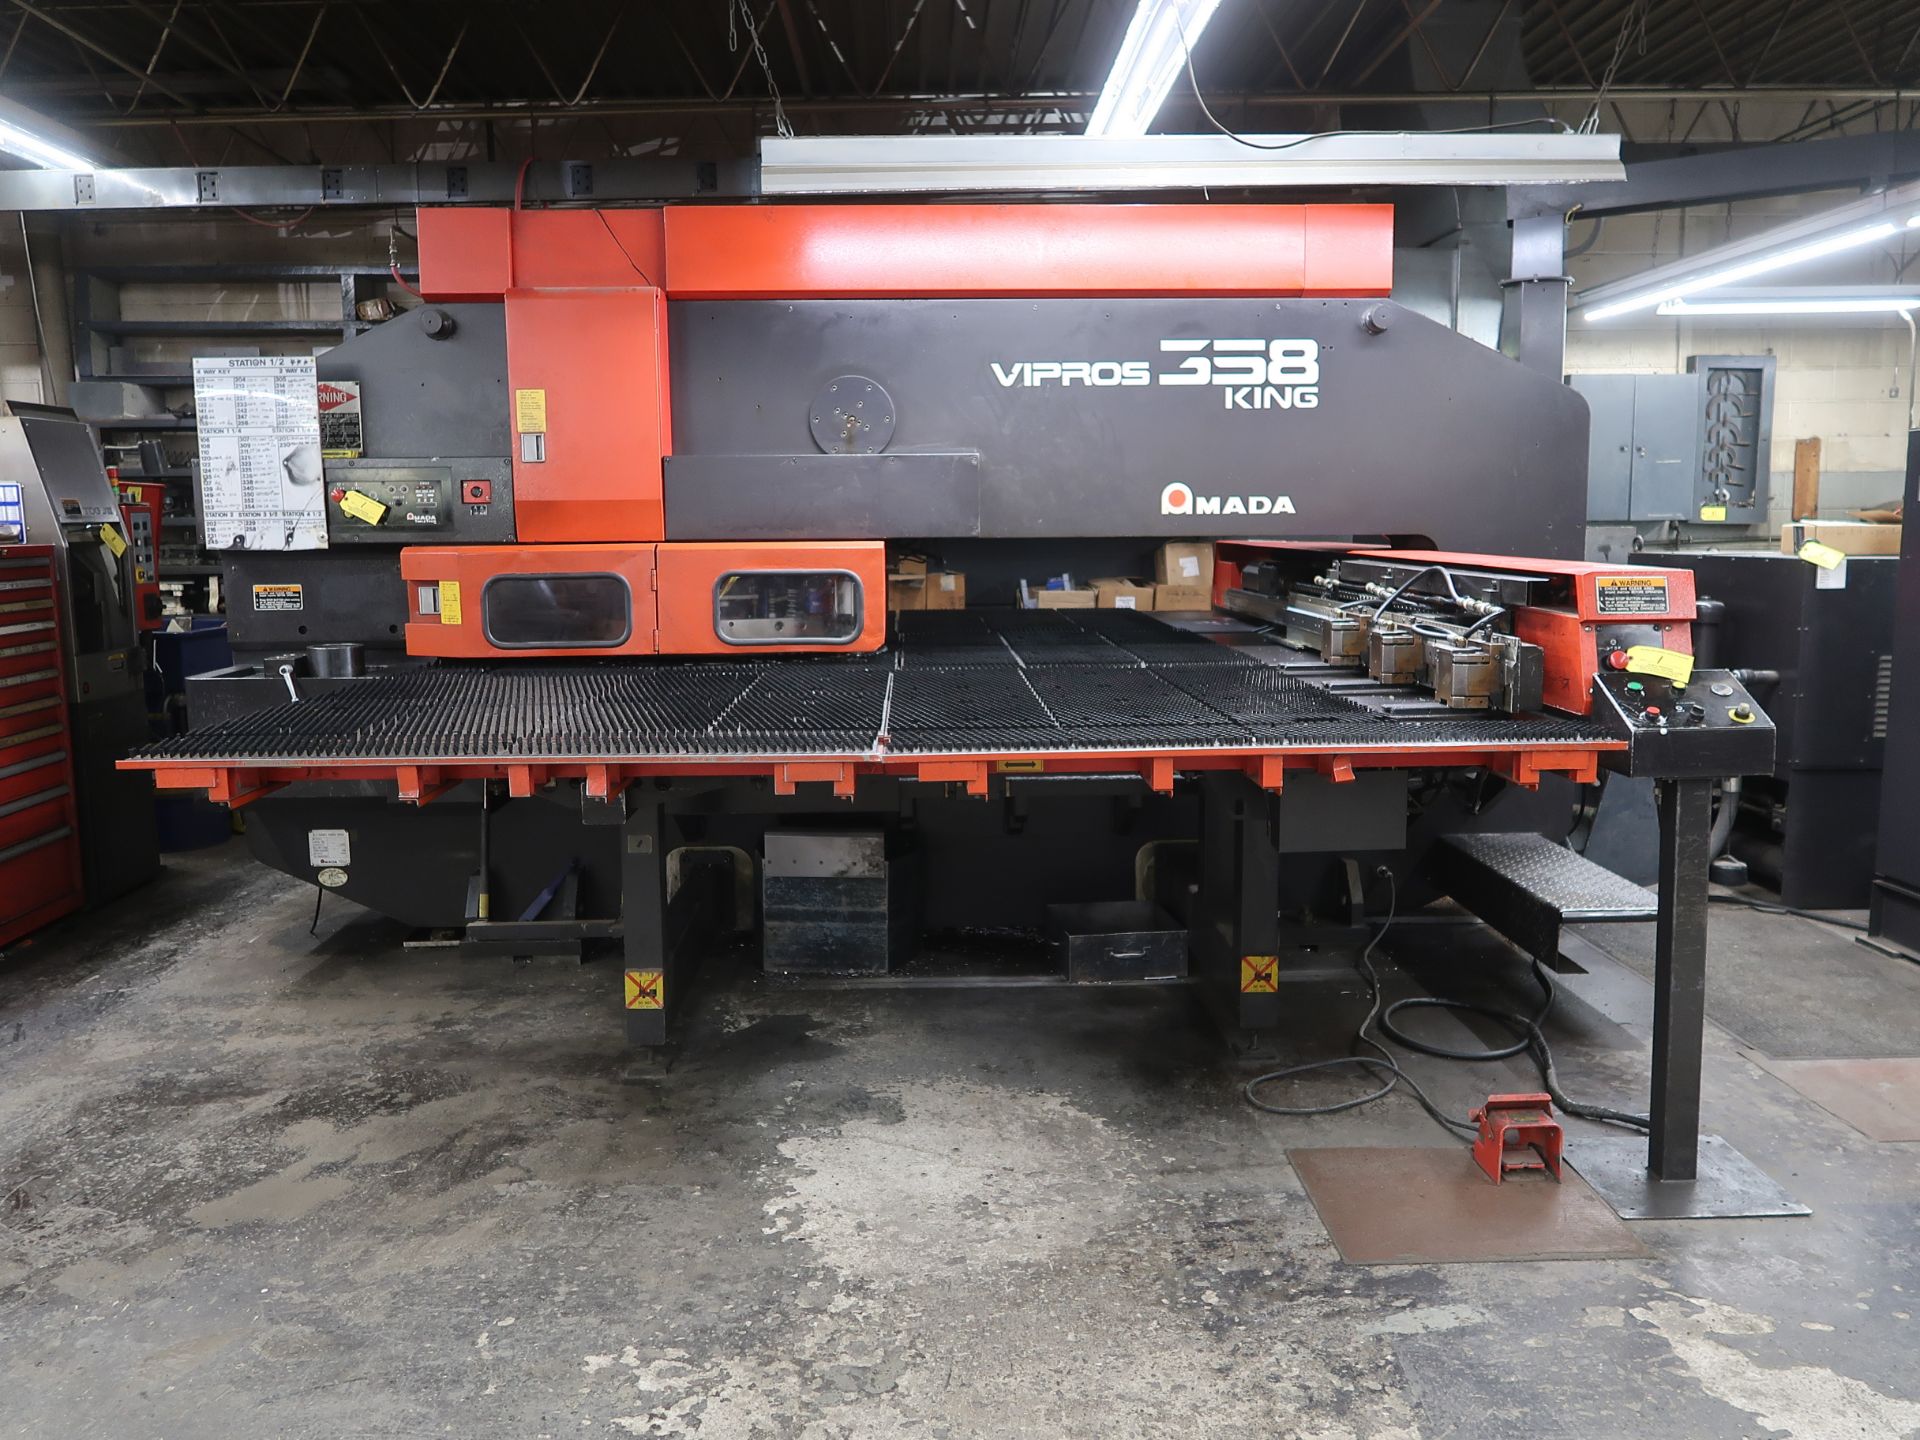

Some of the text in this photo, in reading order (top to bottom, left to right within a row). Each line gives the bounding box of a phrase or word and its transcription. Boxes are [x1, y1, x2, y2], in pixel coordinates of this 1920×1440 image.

[228, 358, 285, 368] STATION 1/2
[990, 338, 1320, 387] VIPROS 358
[318, 391, 347, 403] RNING
[1224, 386, 1319, 410] KING
[1161, 482, 1296, 515] AMADA
[1619, 579, 1652, 587] WARNING
